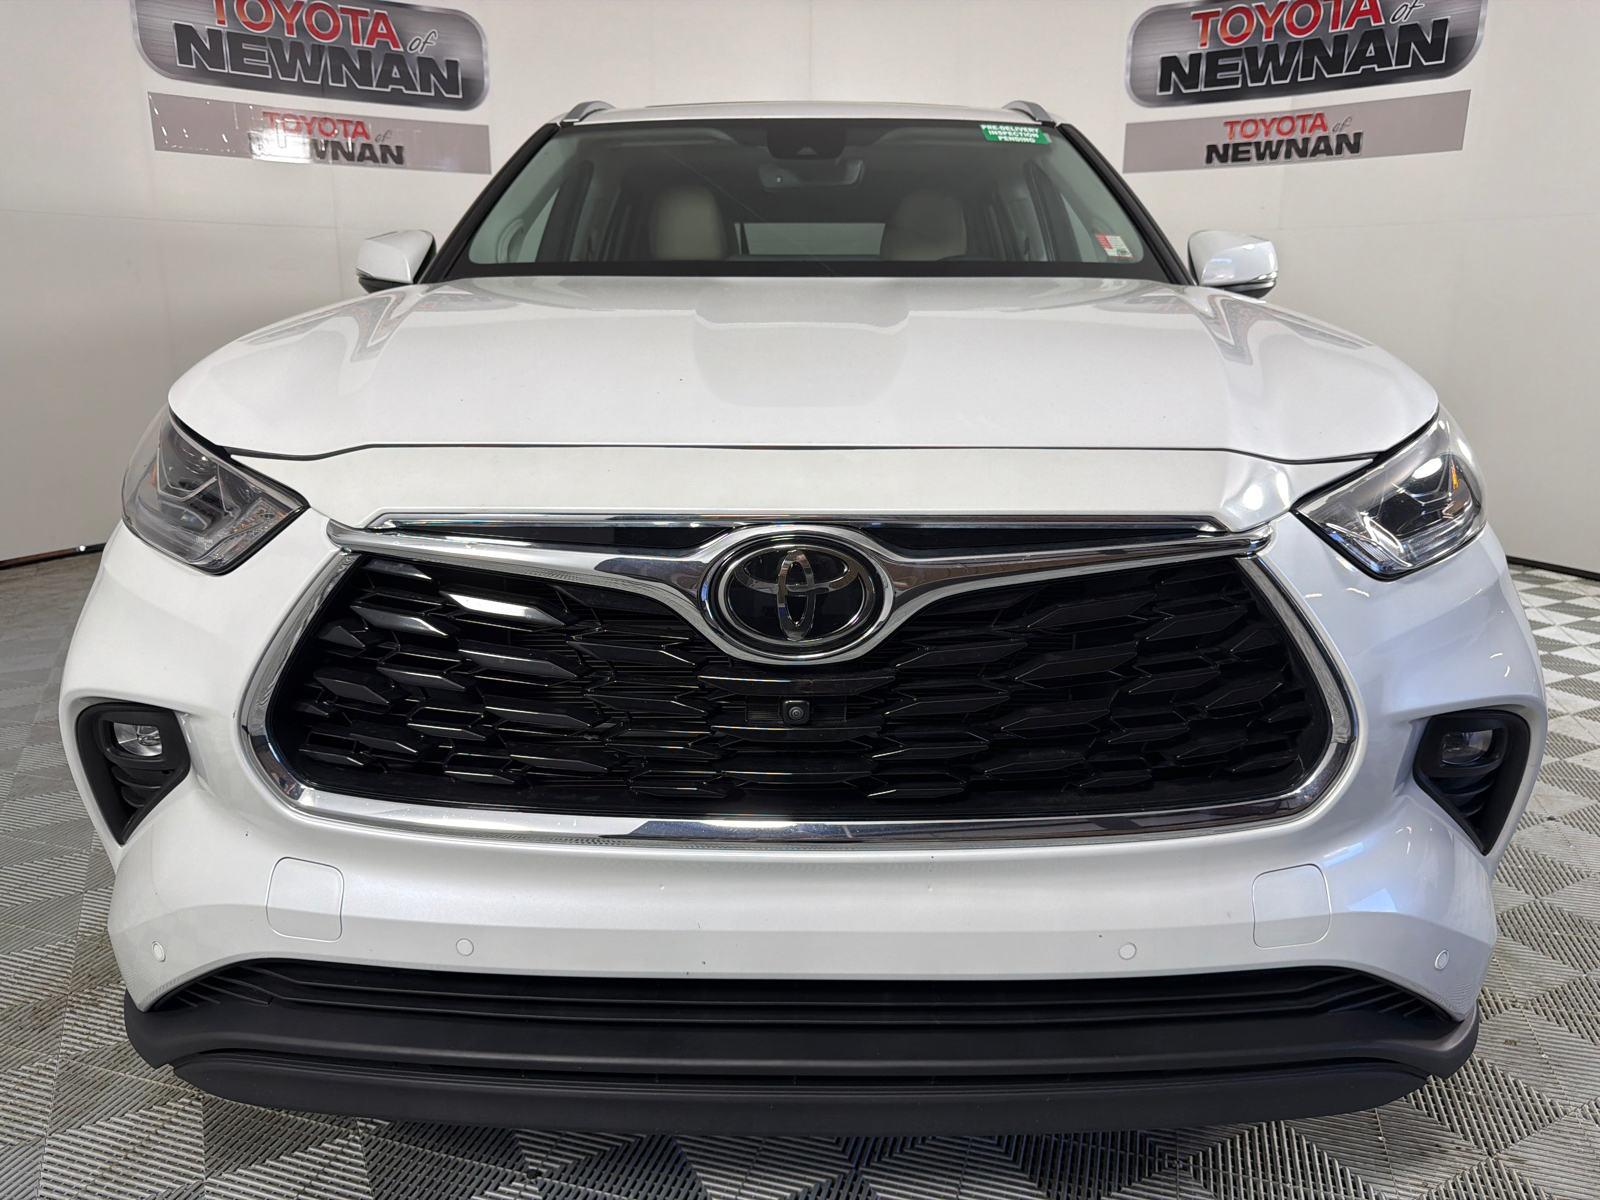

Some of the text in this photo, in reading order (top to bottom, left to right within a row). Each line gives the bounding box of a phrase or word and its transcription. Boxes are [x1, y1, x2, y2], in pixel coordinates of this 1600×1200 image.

[1191, 0, 1424, 48] TOYOTA of
[406, 30, 438, 54] of
[1156, 16, 1450, 96] NEWNAN
[173, 22, 463, 99] NEWNAN
[262, 111, 370, 141] TOYOTA
[981, 124, 1039, 133] PRE-DELIVERY
[988, 130, 1040, 138] INSPECTION
[1223, 113, 1328, 141] TOYOTA
[249, 132, 405, 165] WNAN
[1205, 132, 1362, 164] NEWNAN
